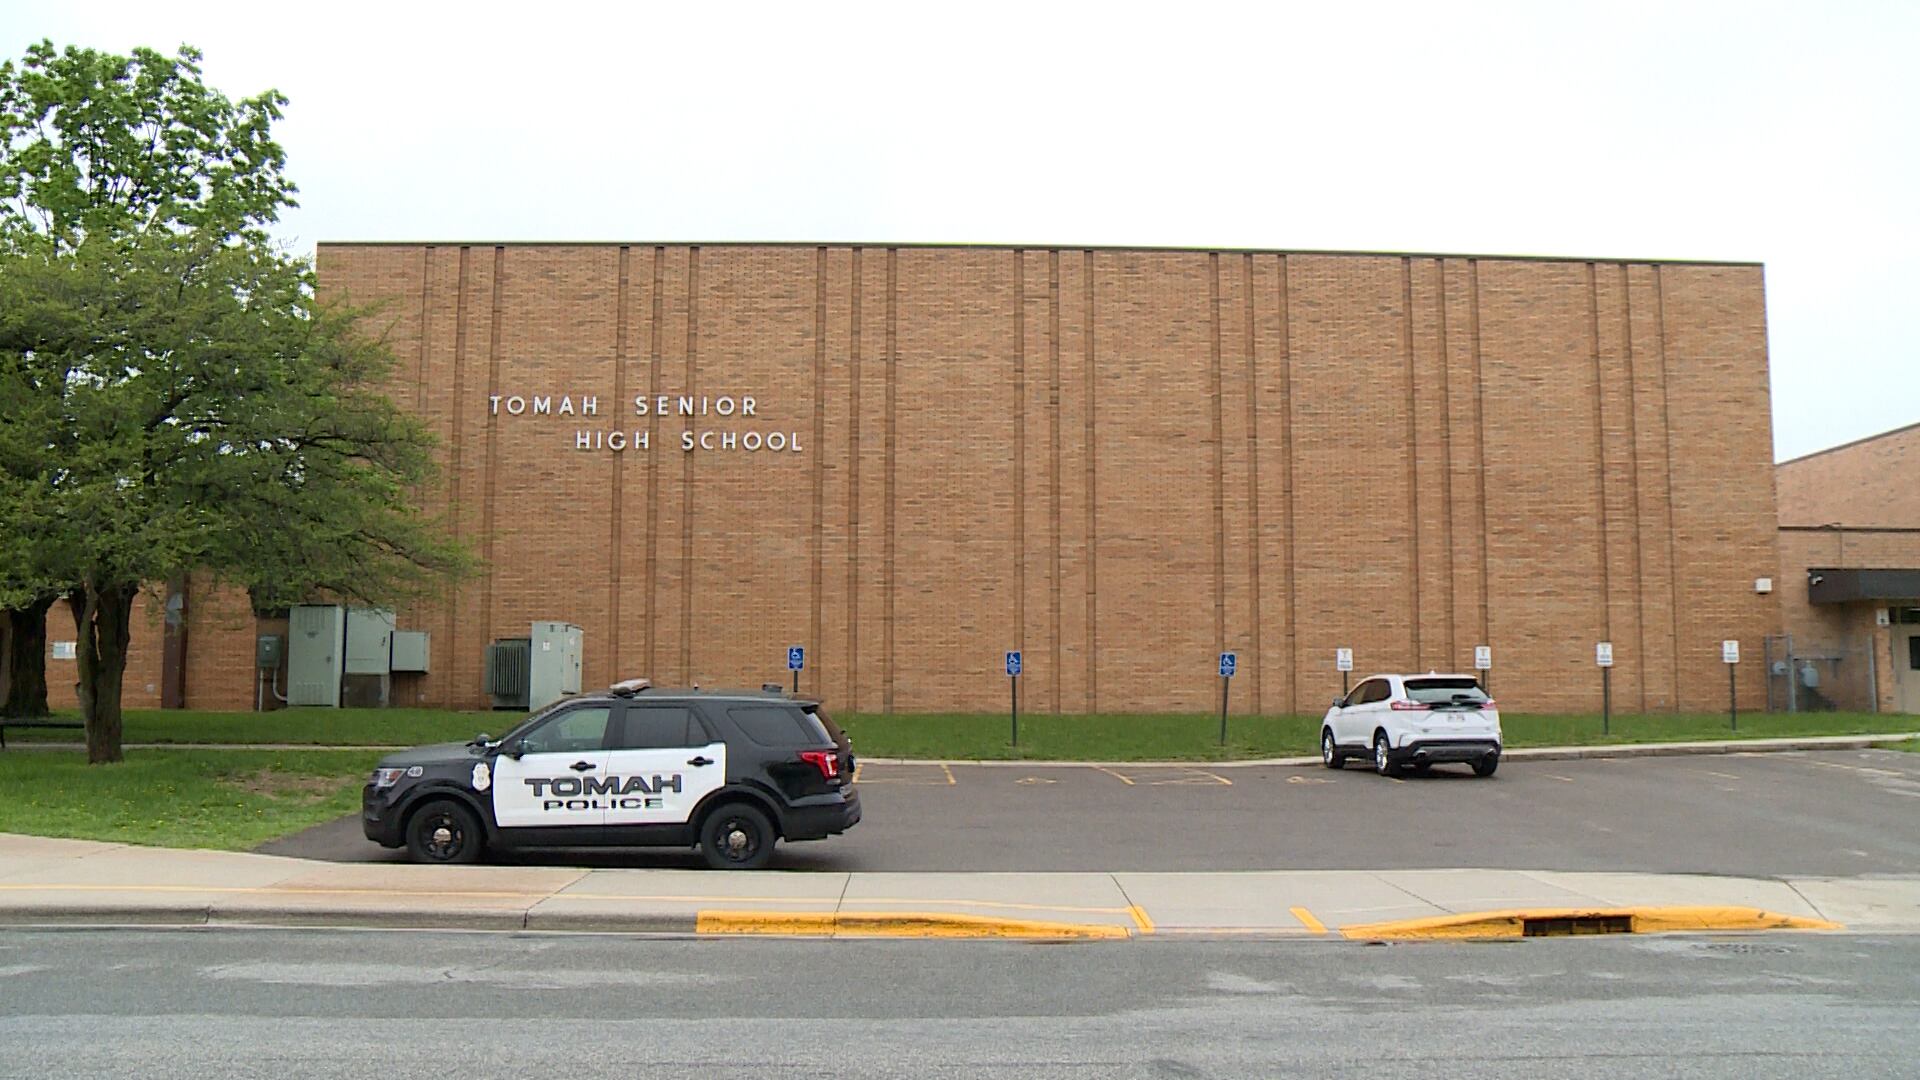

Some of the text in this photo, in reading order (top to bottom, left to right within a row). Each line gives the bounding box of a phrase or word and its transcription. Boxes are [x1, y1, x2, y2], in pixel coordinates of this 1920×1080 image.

[490, 395, 757, 416] TOMAH SENIOR
[576, 430, 803, 452] HIGH SCHOOL
[524, 774, 682, 797] TOMAH
[543, 798, 664, 811] POLICE
